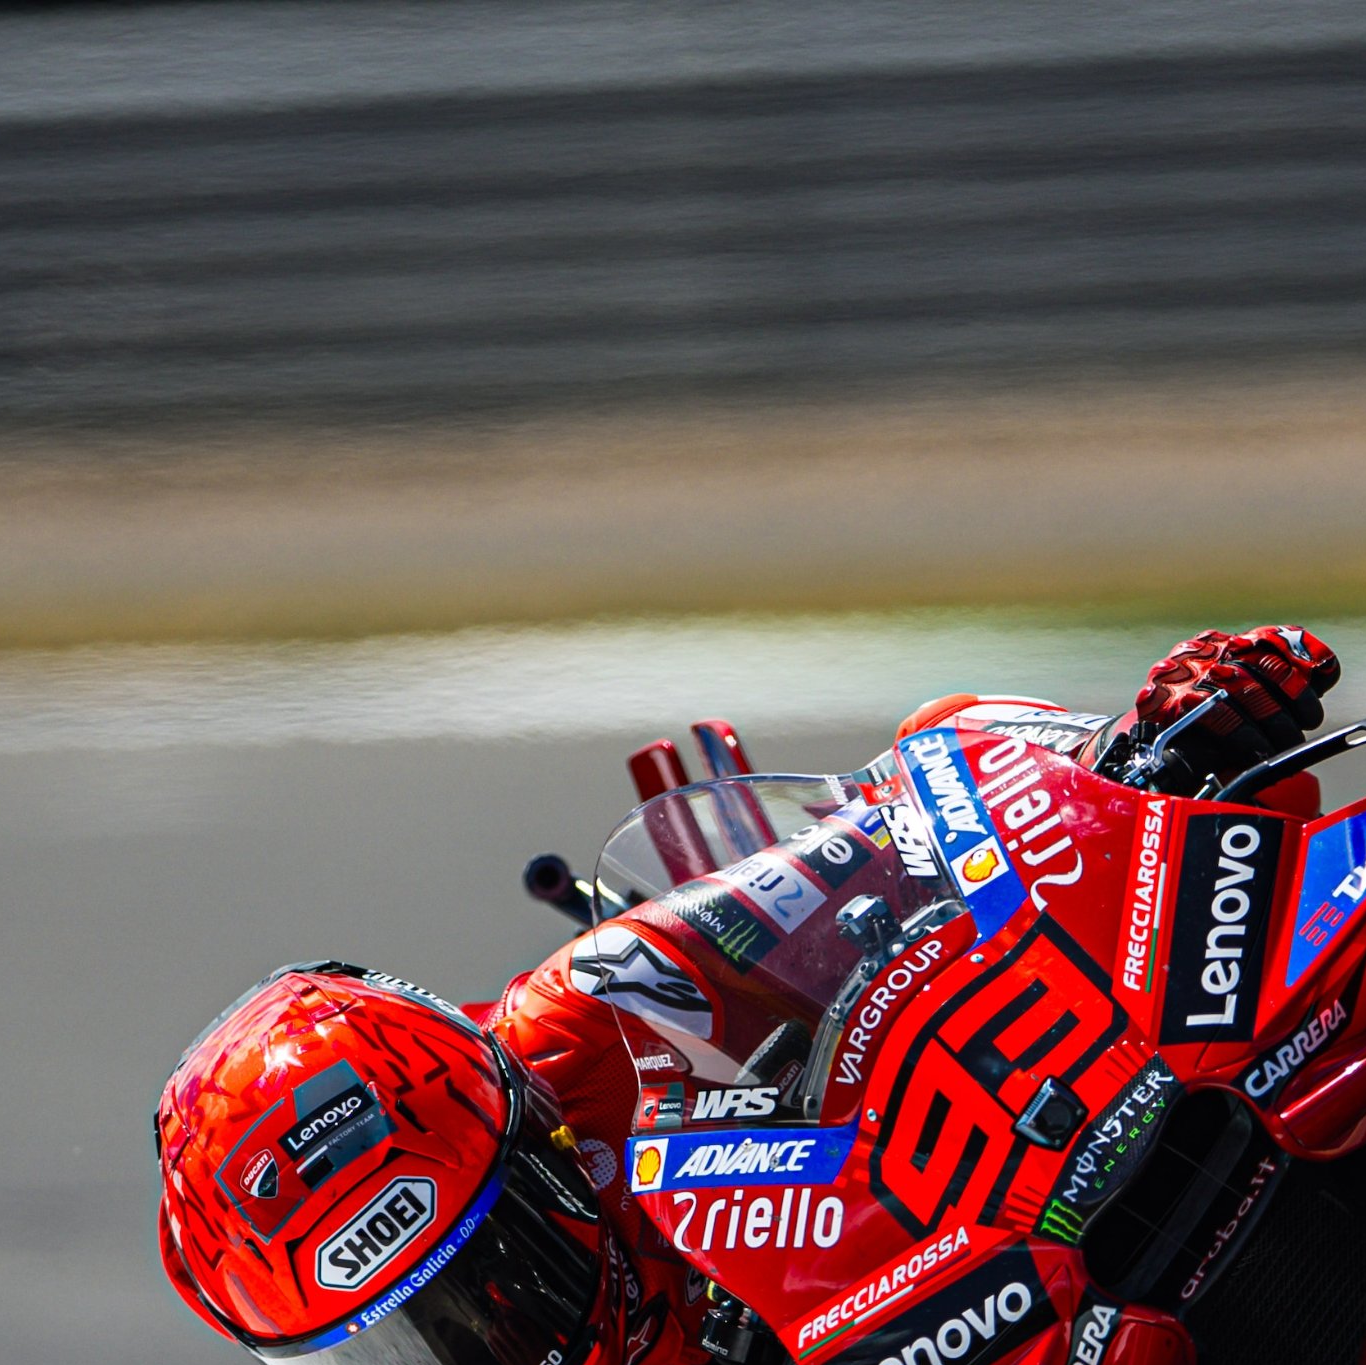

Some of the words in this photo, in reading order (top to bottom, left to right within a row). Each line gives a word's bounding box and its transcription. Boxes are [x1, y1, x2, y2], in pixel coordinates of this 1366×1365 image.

[916, 733, 988, 835] ADVANCE
[1123, 799, 1167, 992] FRECCIAROSSA
[1185, 823, 1261, 1028] Lenovo
[835, 938, 945, 1088] VARGROUP
[1244, 999, 1348, 1099] CARRERA
[287, 1095, 363, 1152] Lenovo
[658, 1100, 682, 1111] Lenovo
[691, 1086, 780, 1120] WRS
[867, 911, 1130, 1242] 93
[242, 1153, 269, 1187] DUCATI
[327, 1126, 357, 1147] FACTORY
[356, 1113, 376, 1131] TEAM
[672, 1138, 816, 1180] ADVANCE
[1093, 1097, 1166, 1190] ENERGY
[328, 1186, 428, 1281] SHOEI
[361, 1285, 415, 1328] Estrella
[409, 1242, 457, 1288] Galicia
[797, 1225, 970, 1350] FRECCIAROSSA
